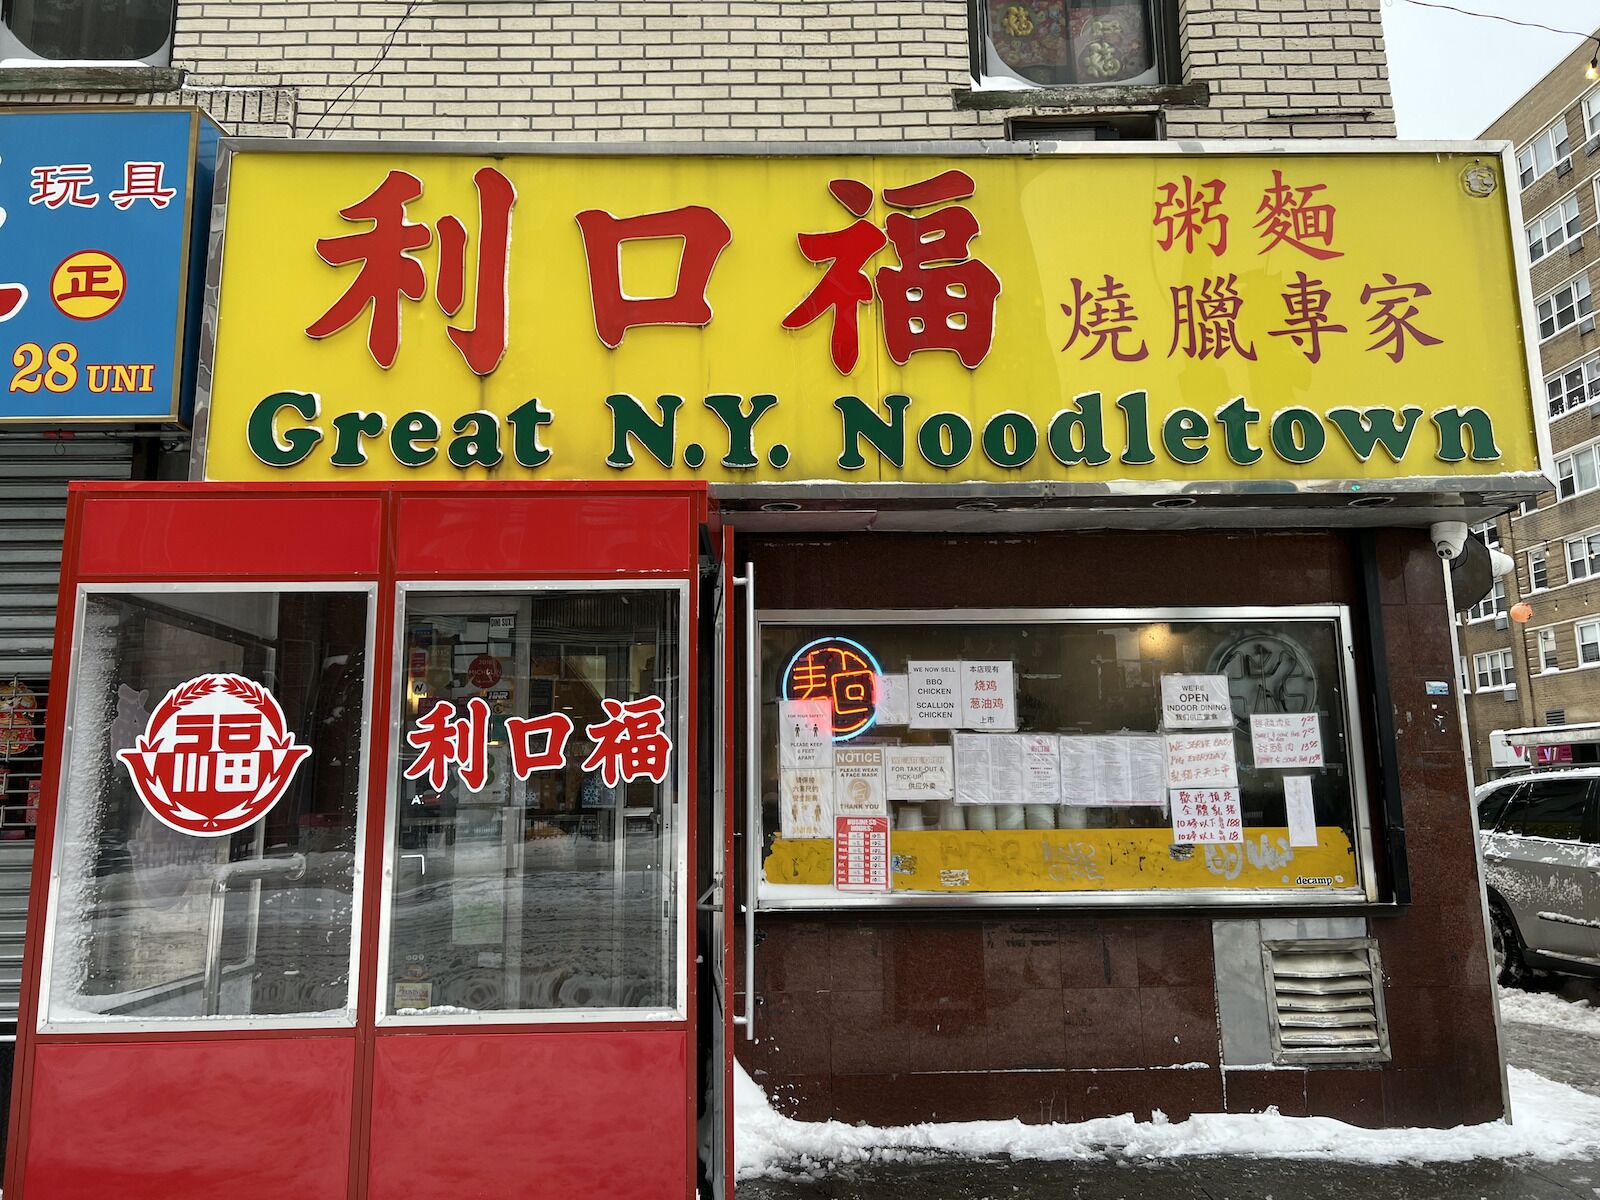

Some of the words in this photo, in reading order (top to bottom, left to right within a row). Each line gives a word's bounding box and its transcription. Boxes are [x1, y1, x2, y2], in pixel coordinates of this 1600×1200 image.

[29, 161, 177, 209] 玩具
[1153, 170, 1345, 261] 粥麵
[57, 264, 121, 302] 正
[305, 167, 1001, 376] 利口福
[1060, 272, 1444, 364] 燒臘專家
[9, 341, 78, 393] 28
[87, 363, 154, 393] UNI
[248, 390, 554, 467] Great
[605, 393, 790, 469] N.Y.
[833, 390, 1503, 470] Noodletown
[925, 678, 943, 686] BBQ
[974, 679, 998, 692] 烧鸡
[1179, 694, 1209, 702] OPEN
[918, 711, 953, 719] CHICKEN
[980, 716, 995, 724] 上市
[173, 713, 263, 793] 福
[404, 695, 673, 793] 利口福
[836, 752, 881, 763] NOTICE
[1169, 741, 1184, 752] WE
[1296, 876, 1333, 886] decamp
